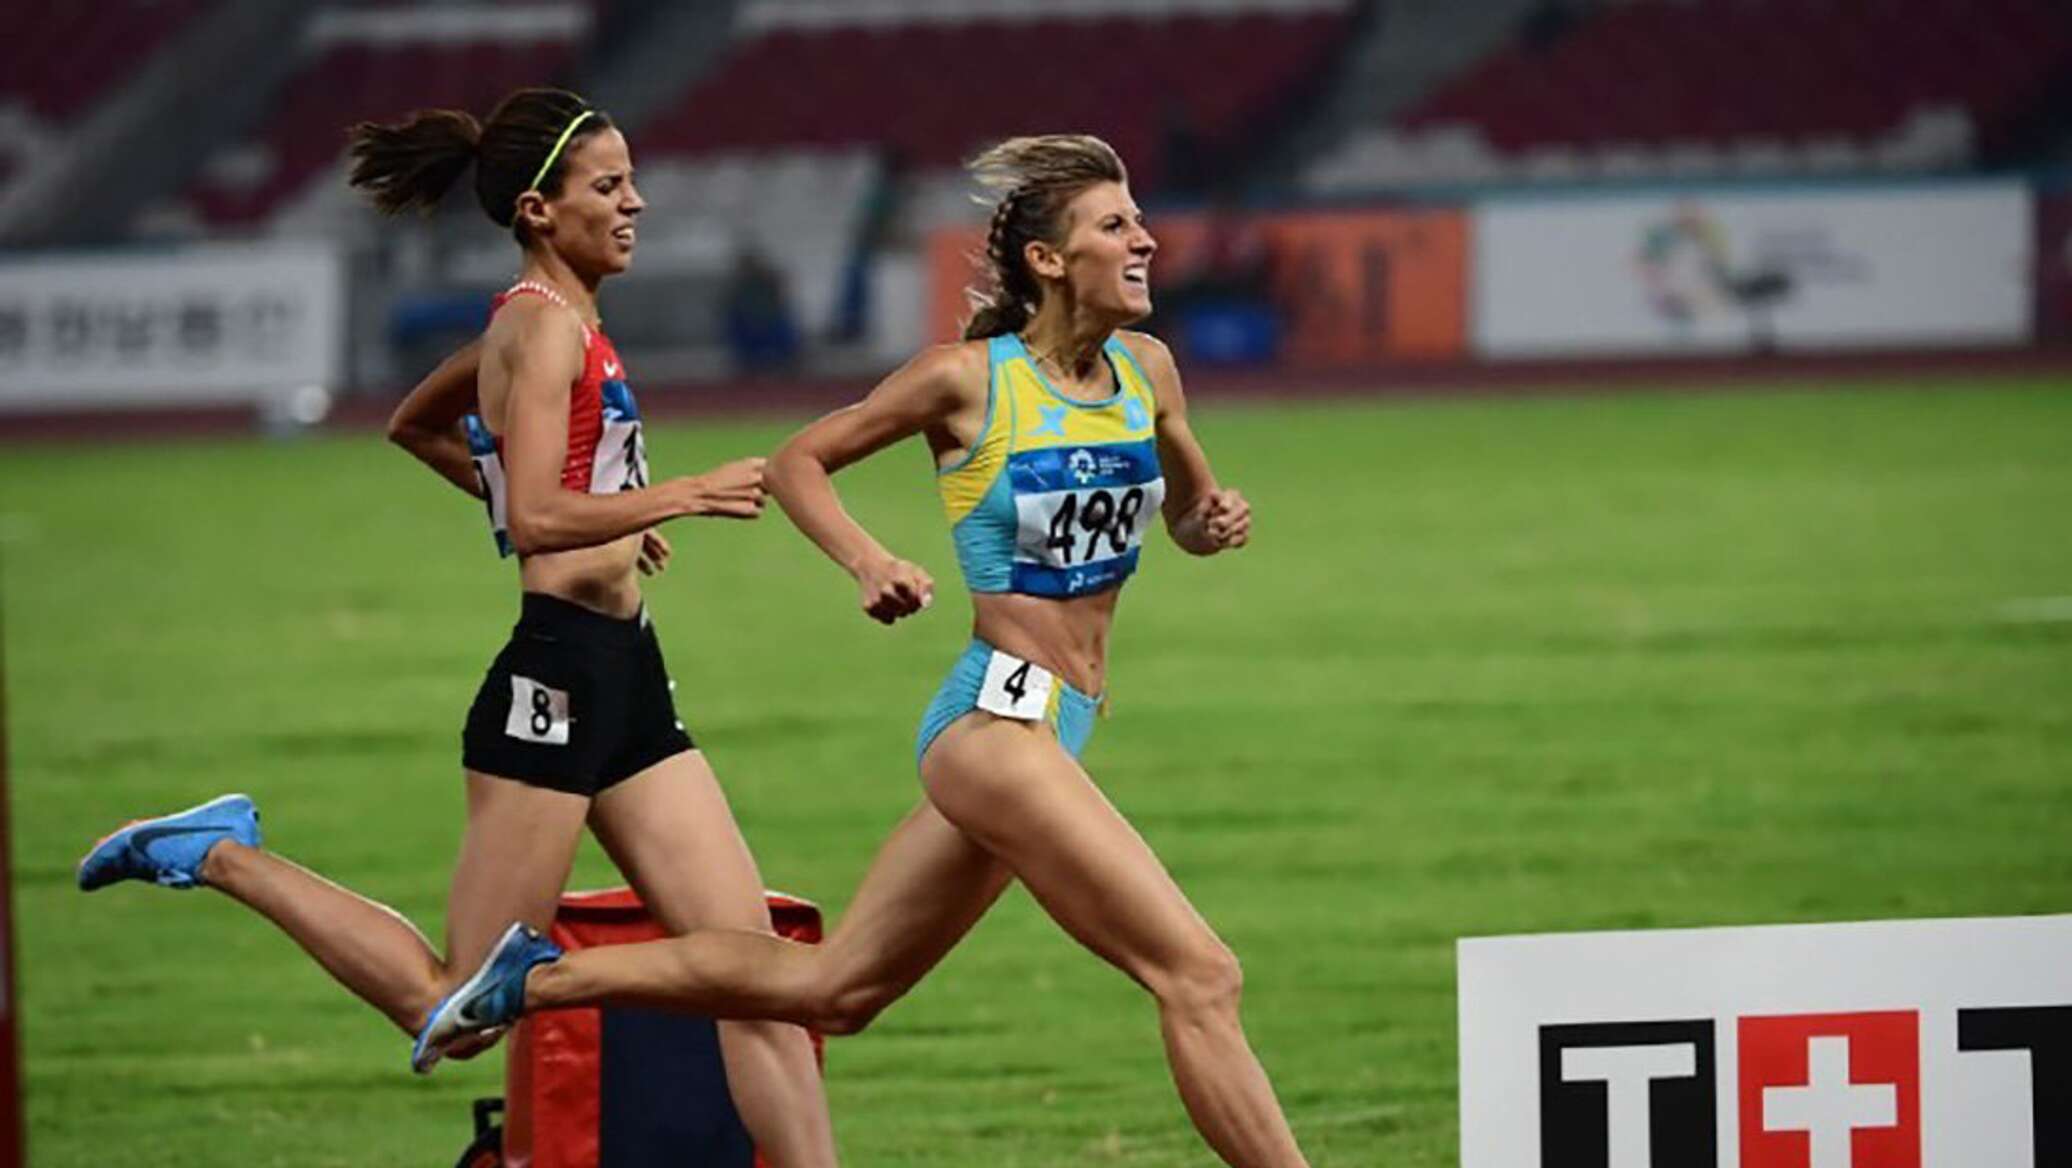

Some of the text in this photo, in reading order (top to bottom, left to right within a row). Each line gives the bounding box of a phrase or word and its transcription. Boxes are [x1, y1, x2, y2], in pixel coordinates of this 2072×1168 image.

[1048, 487, 1144, 563] 498
[1003, 661, 1030, 705] 4
[532, 688, 551, 737] 8
